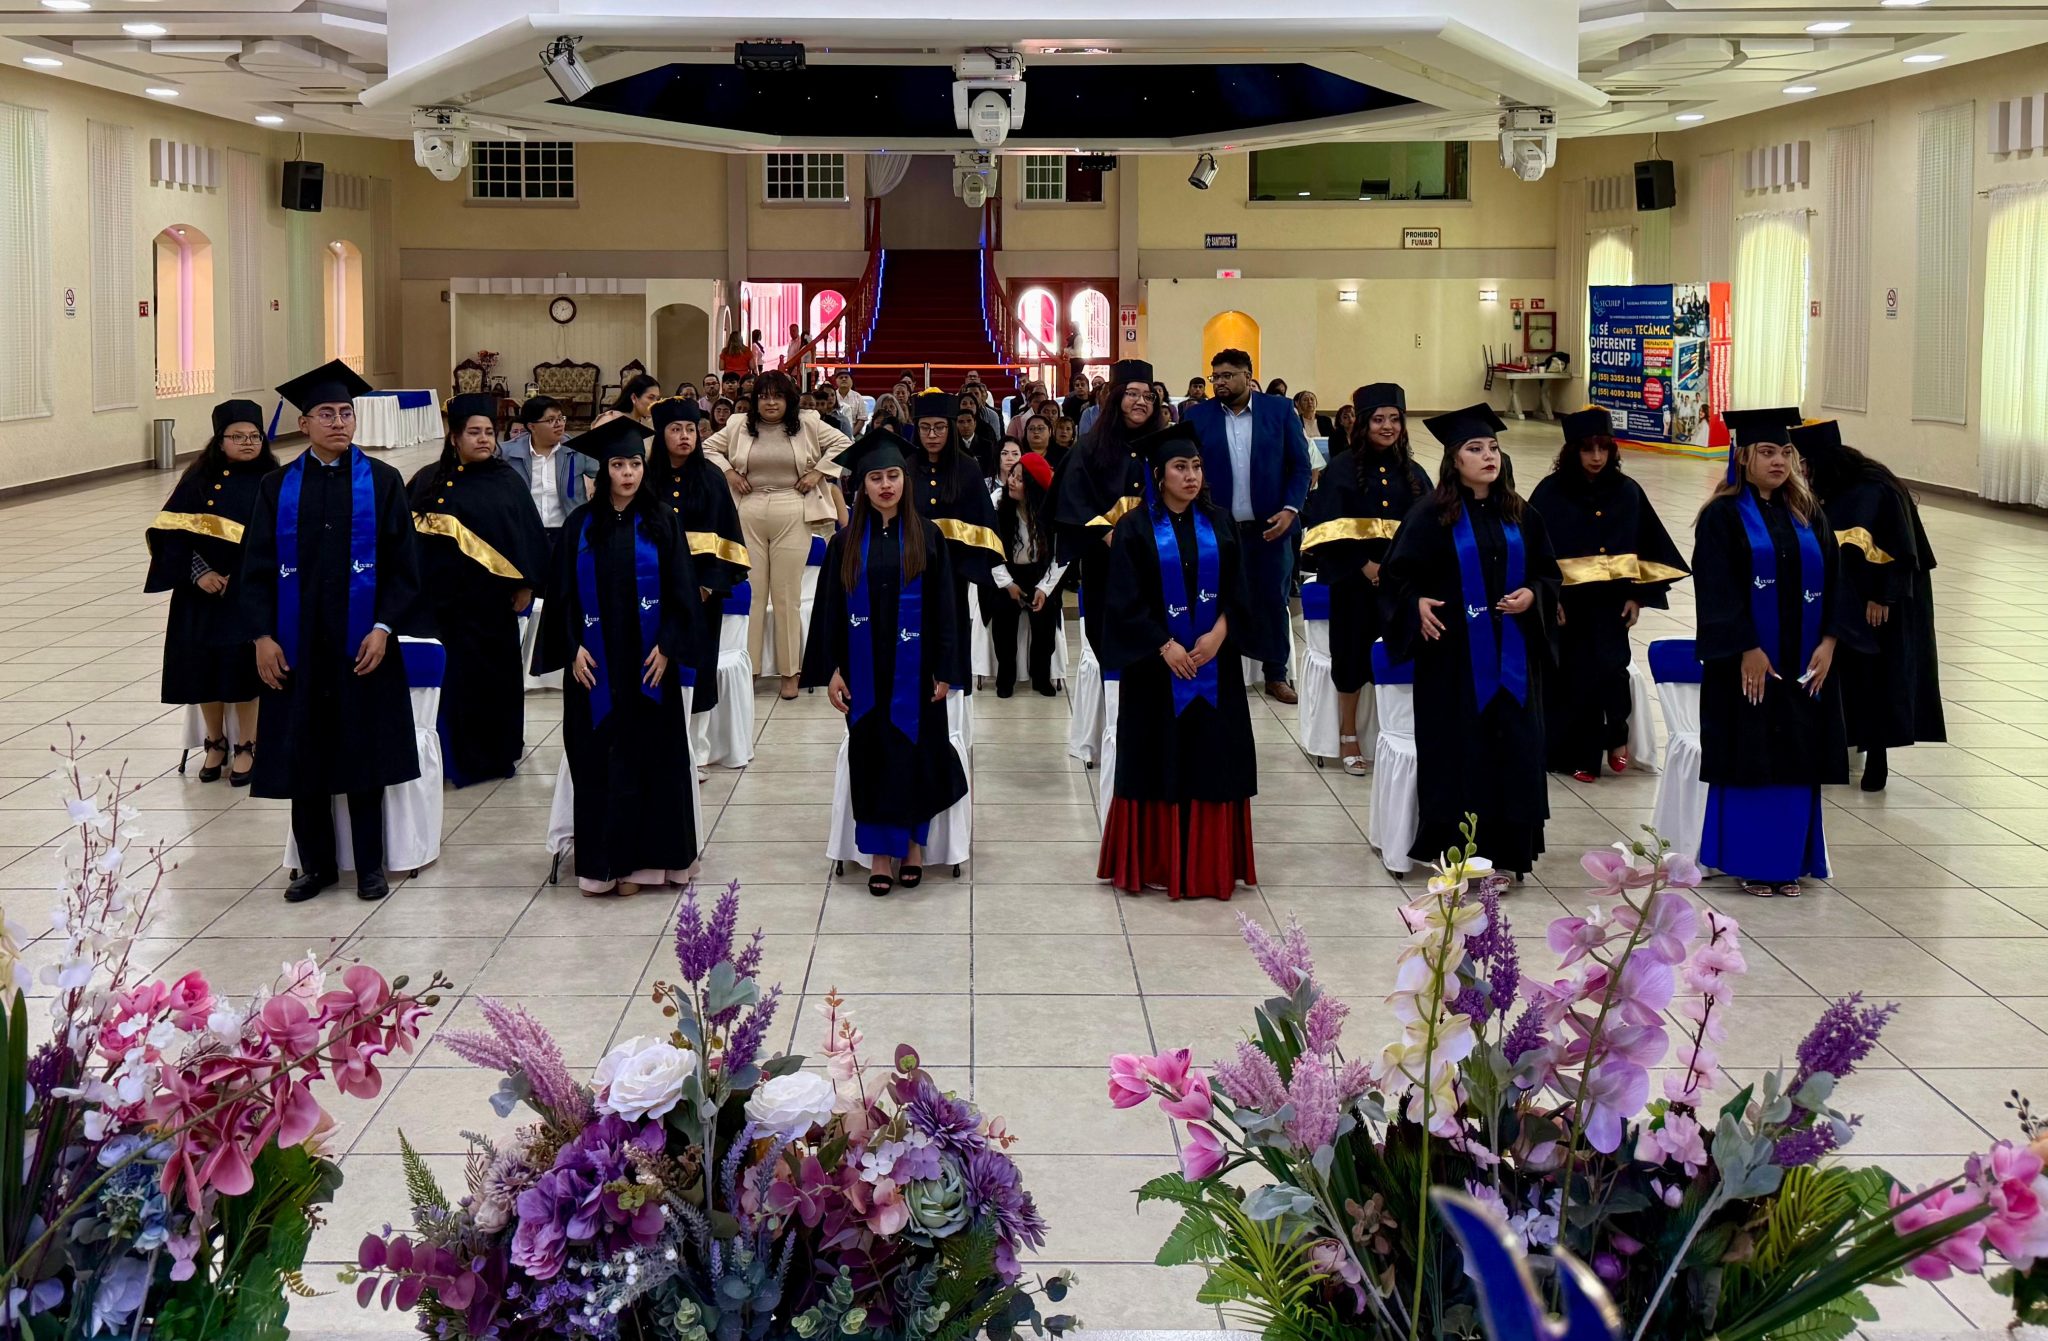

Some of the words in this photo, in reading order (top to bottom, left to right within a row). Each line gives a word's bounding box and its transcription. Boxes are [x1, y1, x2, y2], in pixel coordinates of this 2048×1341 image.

[1612, 327, 1633, 335] CAMPUS
[1635, 322, 1670, 335] TECÁMAC
[1591, 337, 1636, 350] DIFERENTE
[1591, 351, 1600, 364] SÉ
[1598, 373, 1609, 383] (55)
[1610, 374, 1625, 383] 3355
[1626, 376, 1642, 384] 2116
[1598, 388, 1609, 398] (55)
